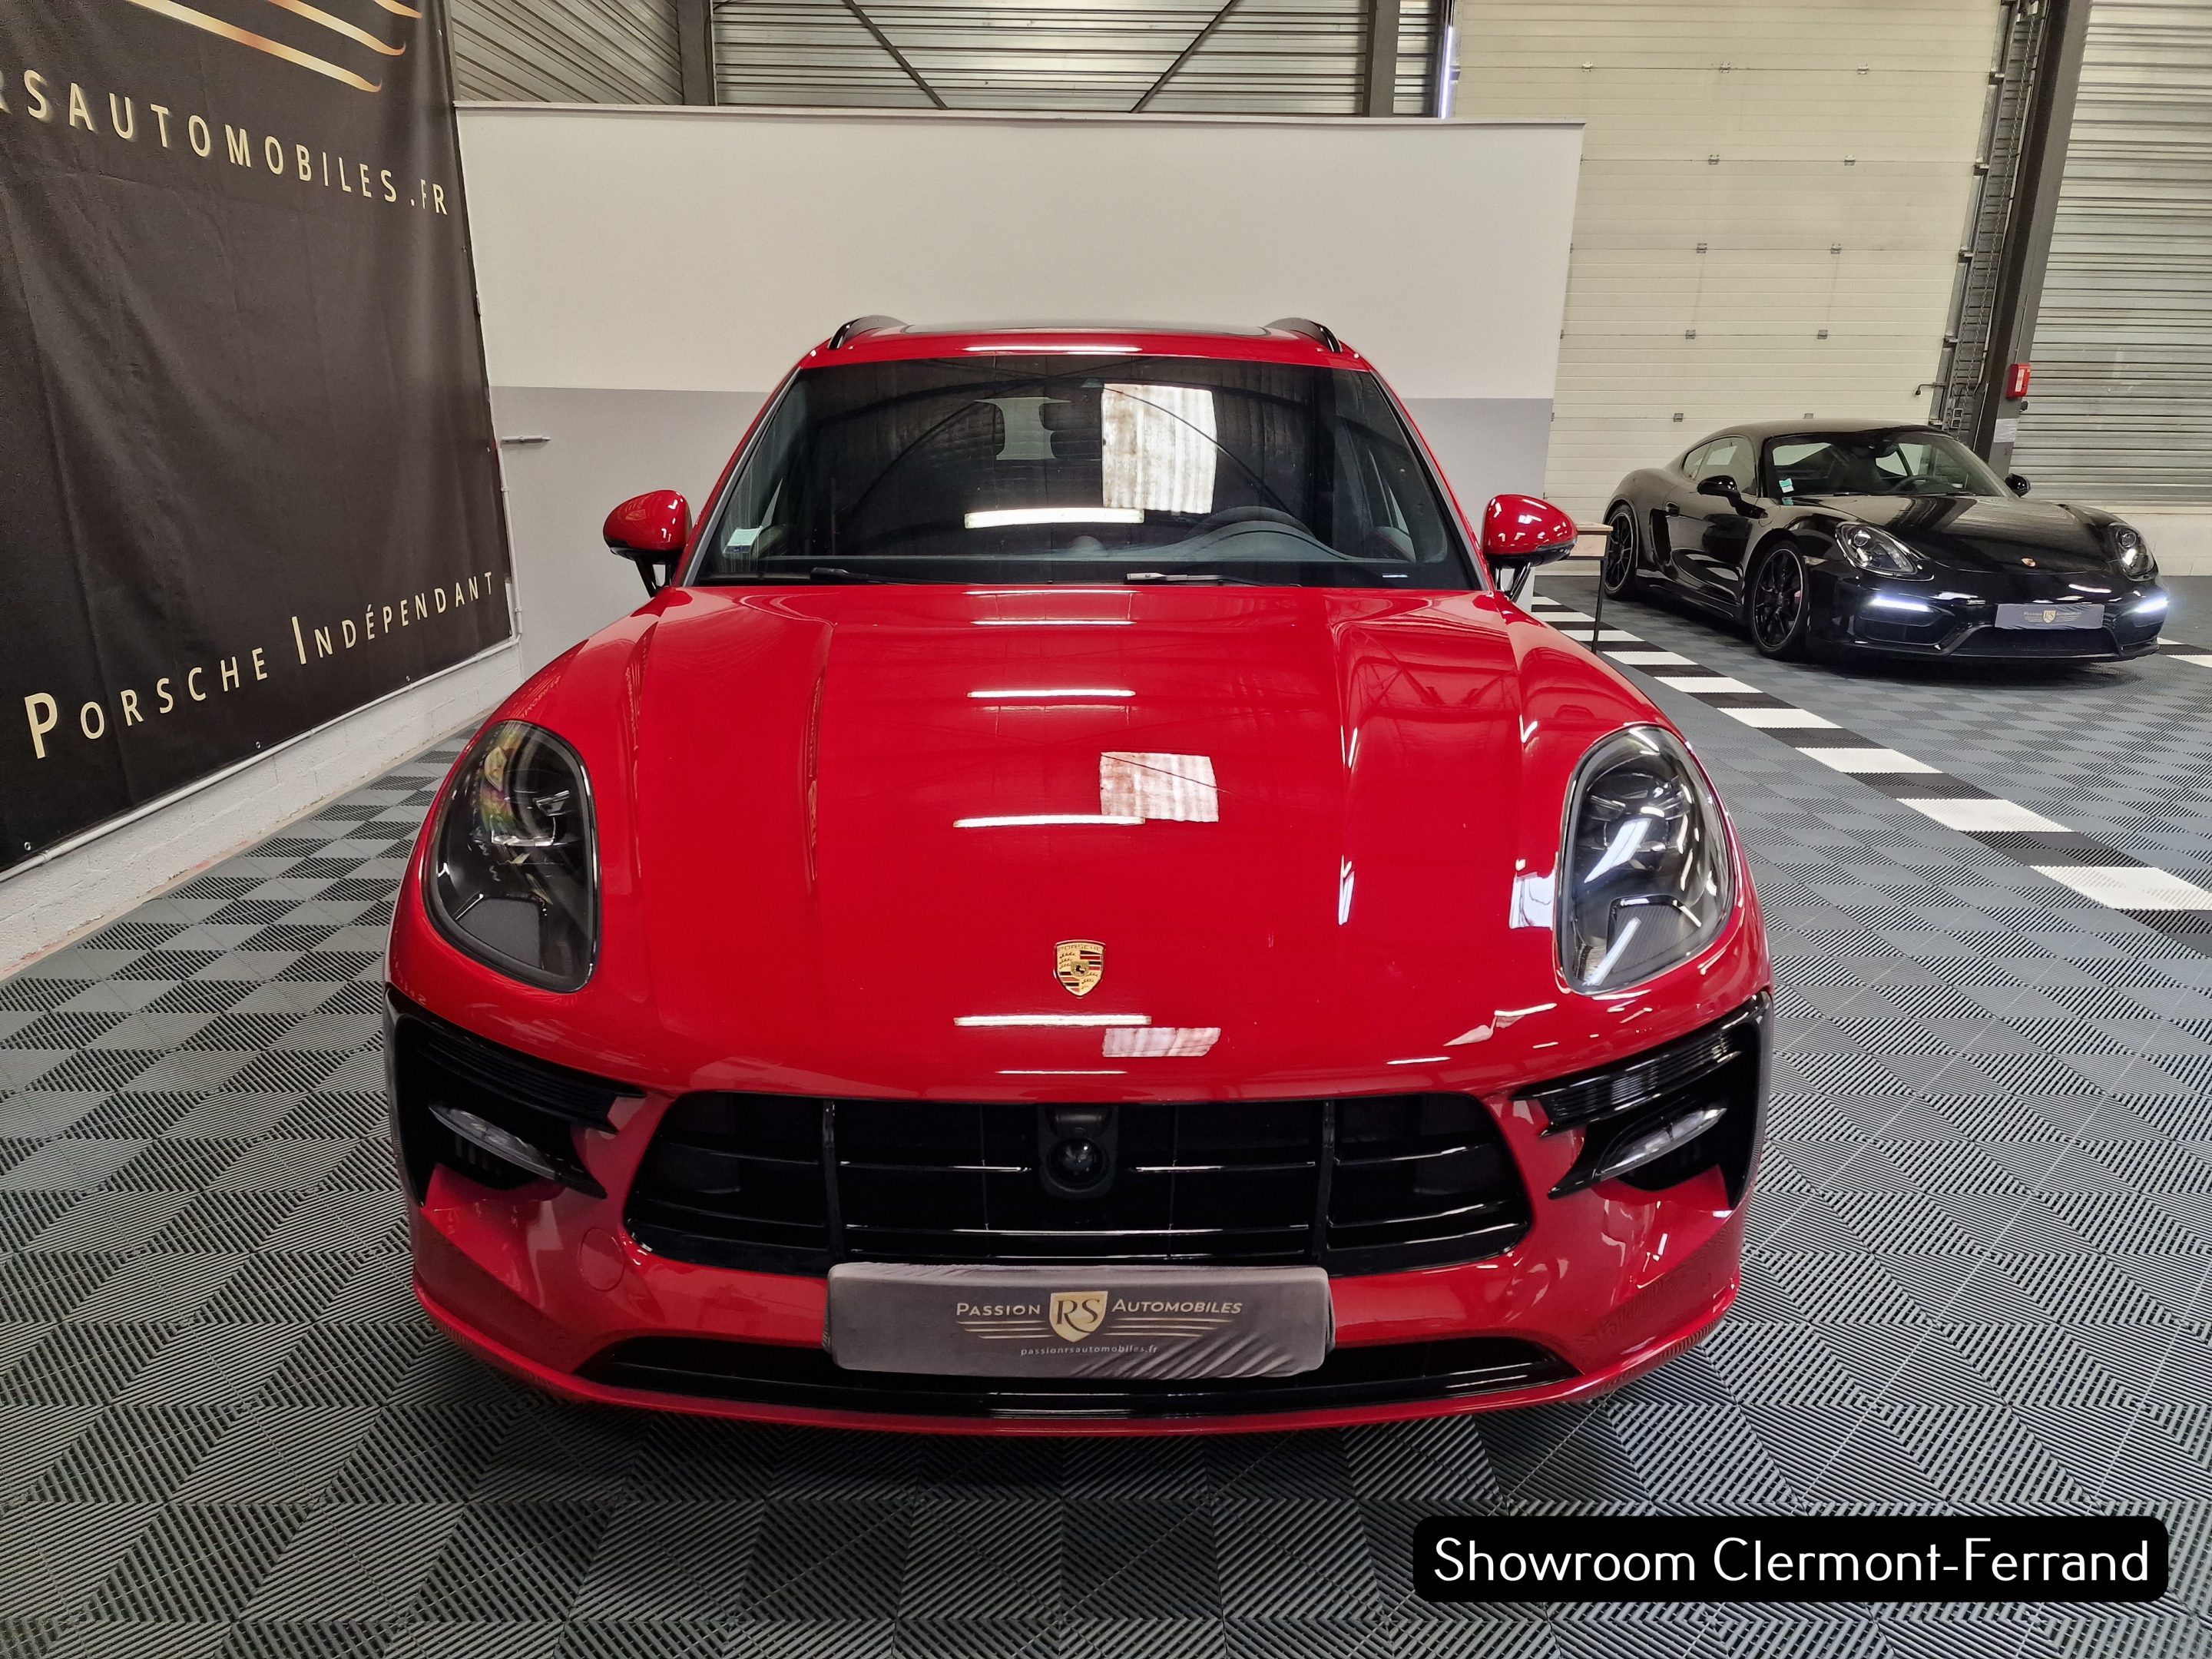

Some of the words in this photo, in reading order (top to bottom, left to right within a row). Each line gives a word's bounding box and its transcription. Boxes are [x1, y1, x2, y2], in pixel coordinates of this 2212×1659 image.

[24, 647, 268, 759] PORSCHE
[291, 571, 494, 665] INDÉPENDANT
[956, 1303, 1041, 1316] PASSION
[1057, 1298, 1100, 1333] RS
[1111, 1299, 1243, 1314] AUTOMOBILES
[1021, 1345, 1158, 1356] passionrsautomobiles.fr
